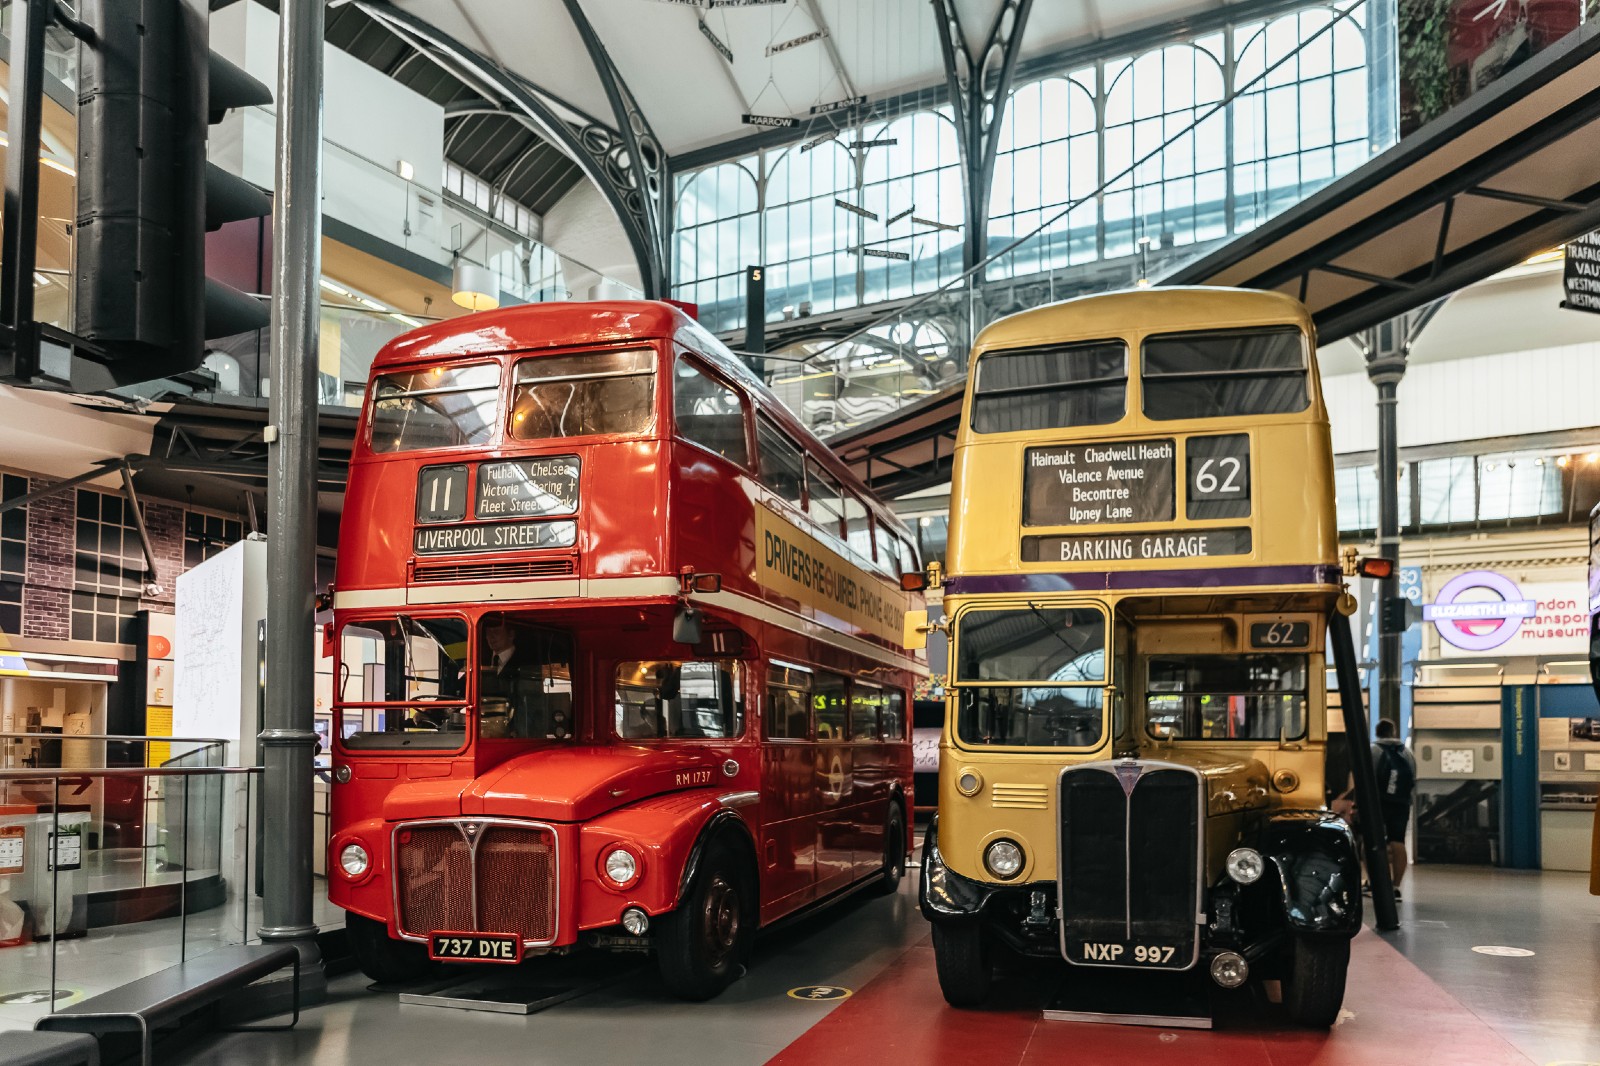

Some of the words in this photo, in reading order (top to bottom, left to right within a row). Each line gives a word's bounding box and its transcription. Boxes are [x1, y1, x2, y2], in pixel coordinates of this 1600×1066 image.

[770, 31, 822, 54] NEASDEN
[837, 97, 861, 109] ROAD
[750, 114, 793, 127] HARROW
[752, 270, 761, 281] 5
[1575, 262, 1600, 277] VAU
[1031, 451, 1076, 467] Hainault
[1084, 446, 1136, 464] Chadwell
[1138, 443, 1173, 460] Heath
[530, 462, 570, 477] Chelsea
[1059, 468, 1102, 484] Valence
[1106, 465, 1144, 481] Avenue
[1195, 456, 1241, 494] 62
[430, 477, 452, 512] 11
[482, 483, 519, 497] Victoria
[1072, 486, 1129, 502] Becontree
[480, 499, 506, 514] Fleet
[509, 497, 541, 512] Street
[1069, 506, 1101, 523] Upney
[1106, 503, 1133, 518] Lane
[417, 527, 488, 549] LIVERPOOL
[494, 525, 542, 545] STREET
[1060, 539, 1132, 561] BARKING
[1141, 536, 1208, 557] GARAGE
[764, 529, 812, 589] DRIVERS
[1430, 605, 1498, 618] ELIZABETH
[1500, 603, 1530, 615] LINE
[1536, 599, 1576, 611] ndon
[1521, 614, 1590, 626] transpor
[712, 632, 725, 652] 11
[1267, 623, 1294, 644] 62
[1521, 628, 1590, 639] museum
[676, 774, 690, 785] RM
[693, 771, 711, 783] 1737
[438, 938, 473, 956] 737
[479, 940, 513, 958] DYE
[1083, 942, 1124, 961] NXP
[1134, 945, 1175, 964] 997
